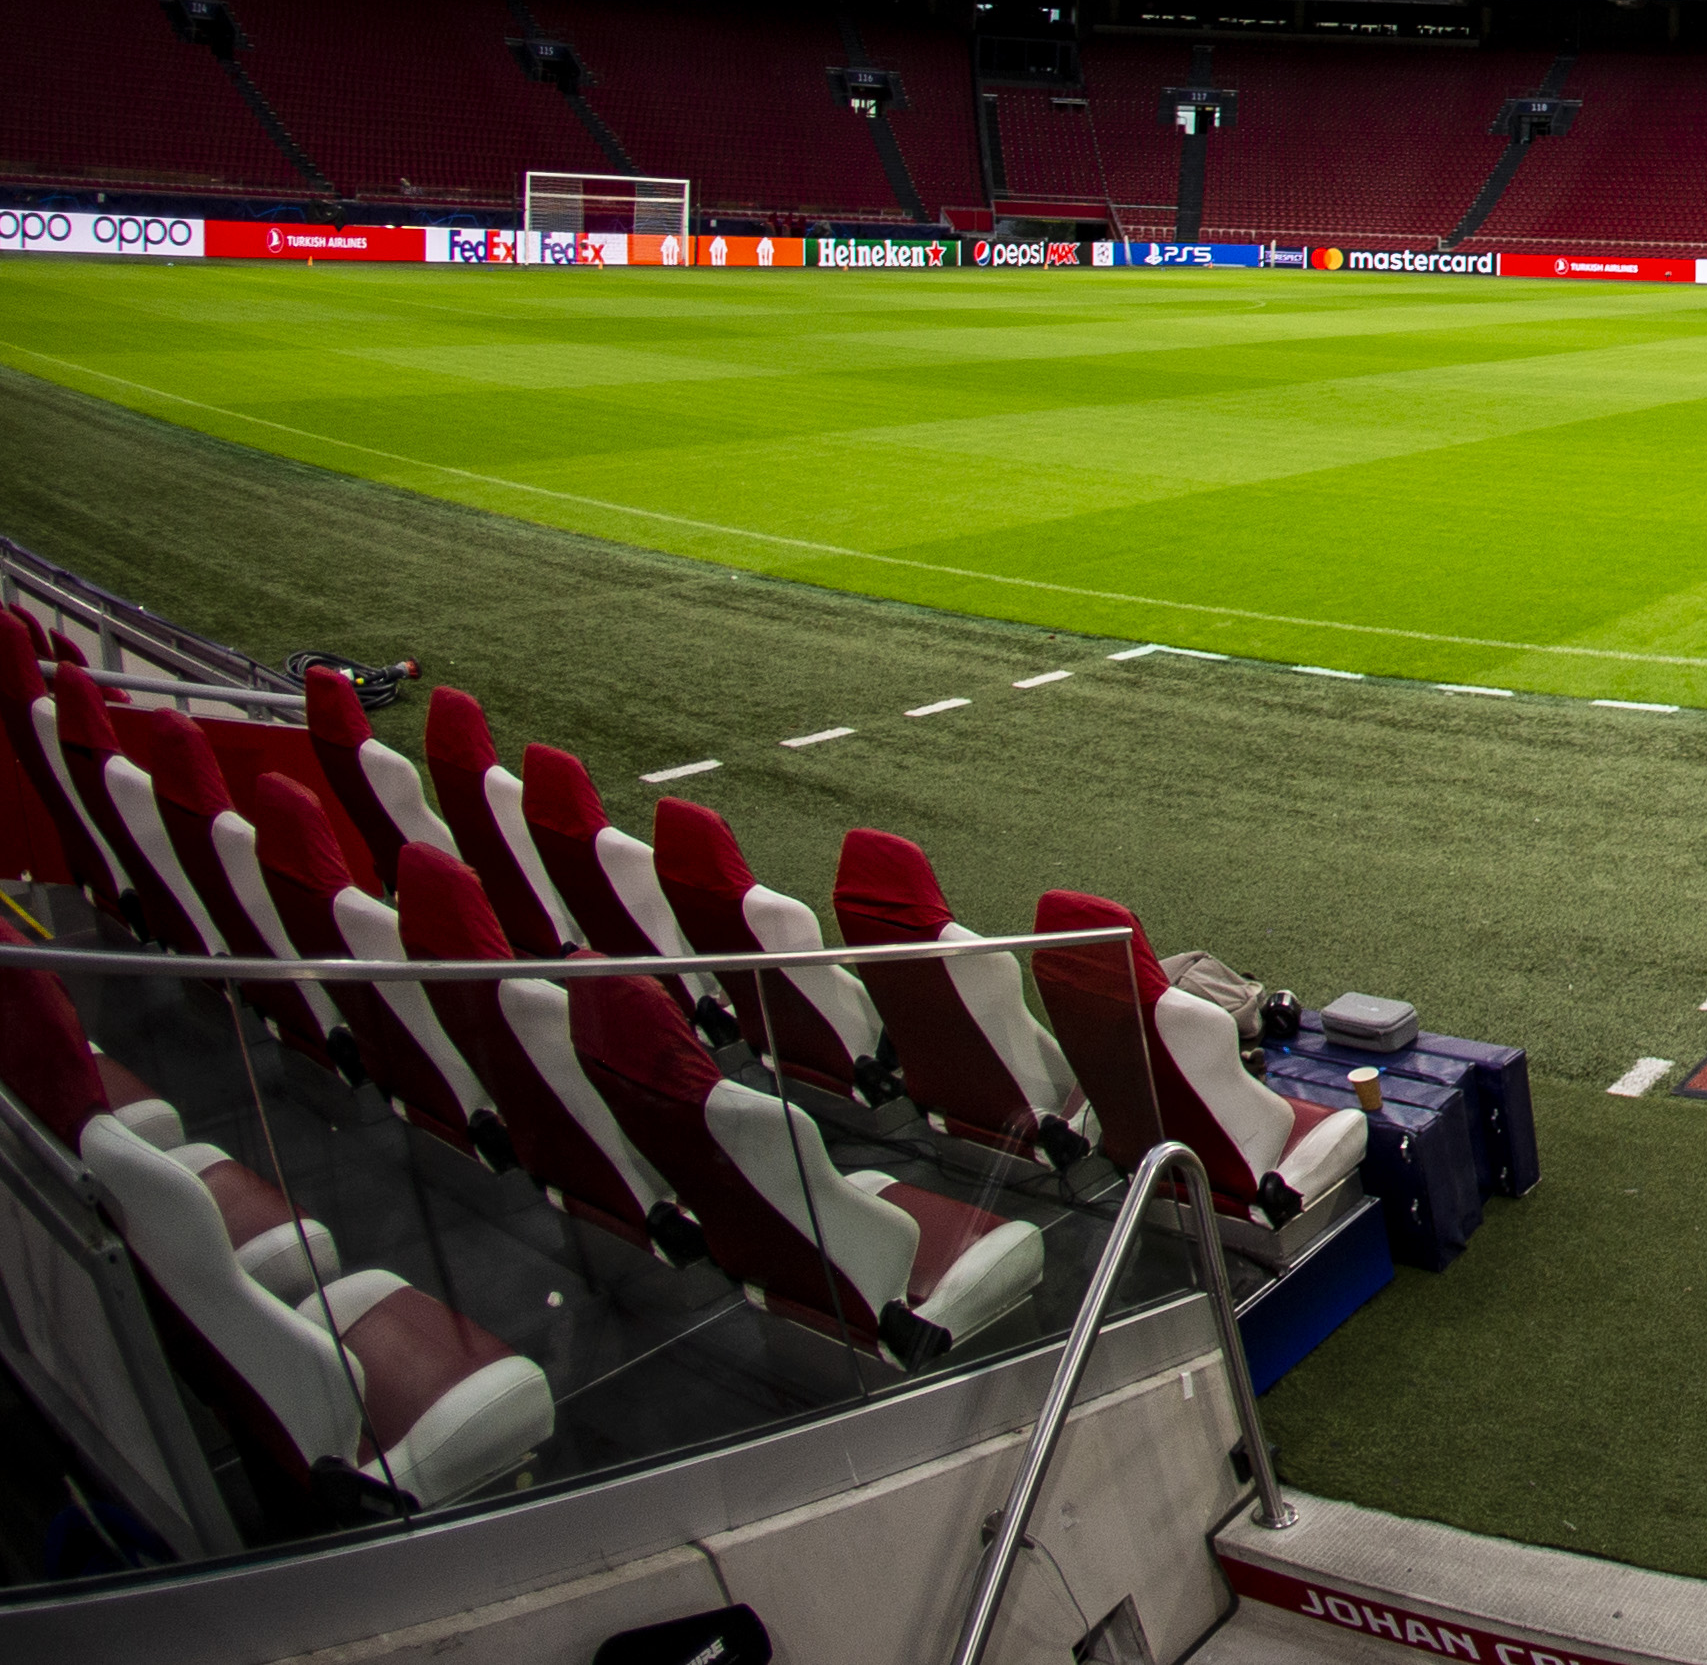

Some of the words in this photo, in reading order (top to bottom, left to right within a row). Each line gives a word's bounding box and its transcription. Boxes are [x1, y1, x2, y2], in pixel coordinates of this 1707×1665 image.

[538, 45, 555, 56] 115
[857, 73, 874, 83] 116
[1192, 92, 1208, 101] 117
[1531, 103, 1548, 112] 118
[93, 216, 193, 252] oppo
[287, 235, 327, 248] TURKISH
[327, 237, 368, 249] AIRLINES
[449, 229, 516, 263] FedEx
[541, 231, 605, 265] FedEx
[818, 238, 926, 266] Heineken
[993, 242, 1046, 267] pepsi
[1046, 242, 1081, 266] MAX
[1164, 246, 1212, 263] PS5
[1349, 250, 1493, 274] mastercard
[1570, 262, 1603, 272] TURKISH
[1603, 263, 1638, 274] AIRLINES
[1301, 1588, 1482, 1662] JOHAN
